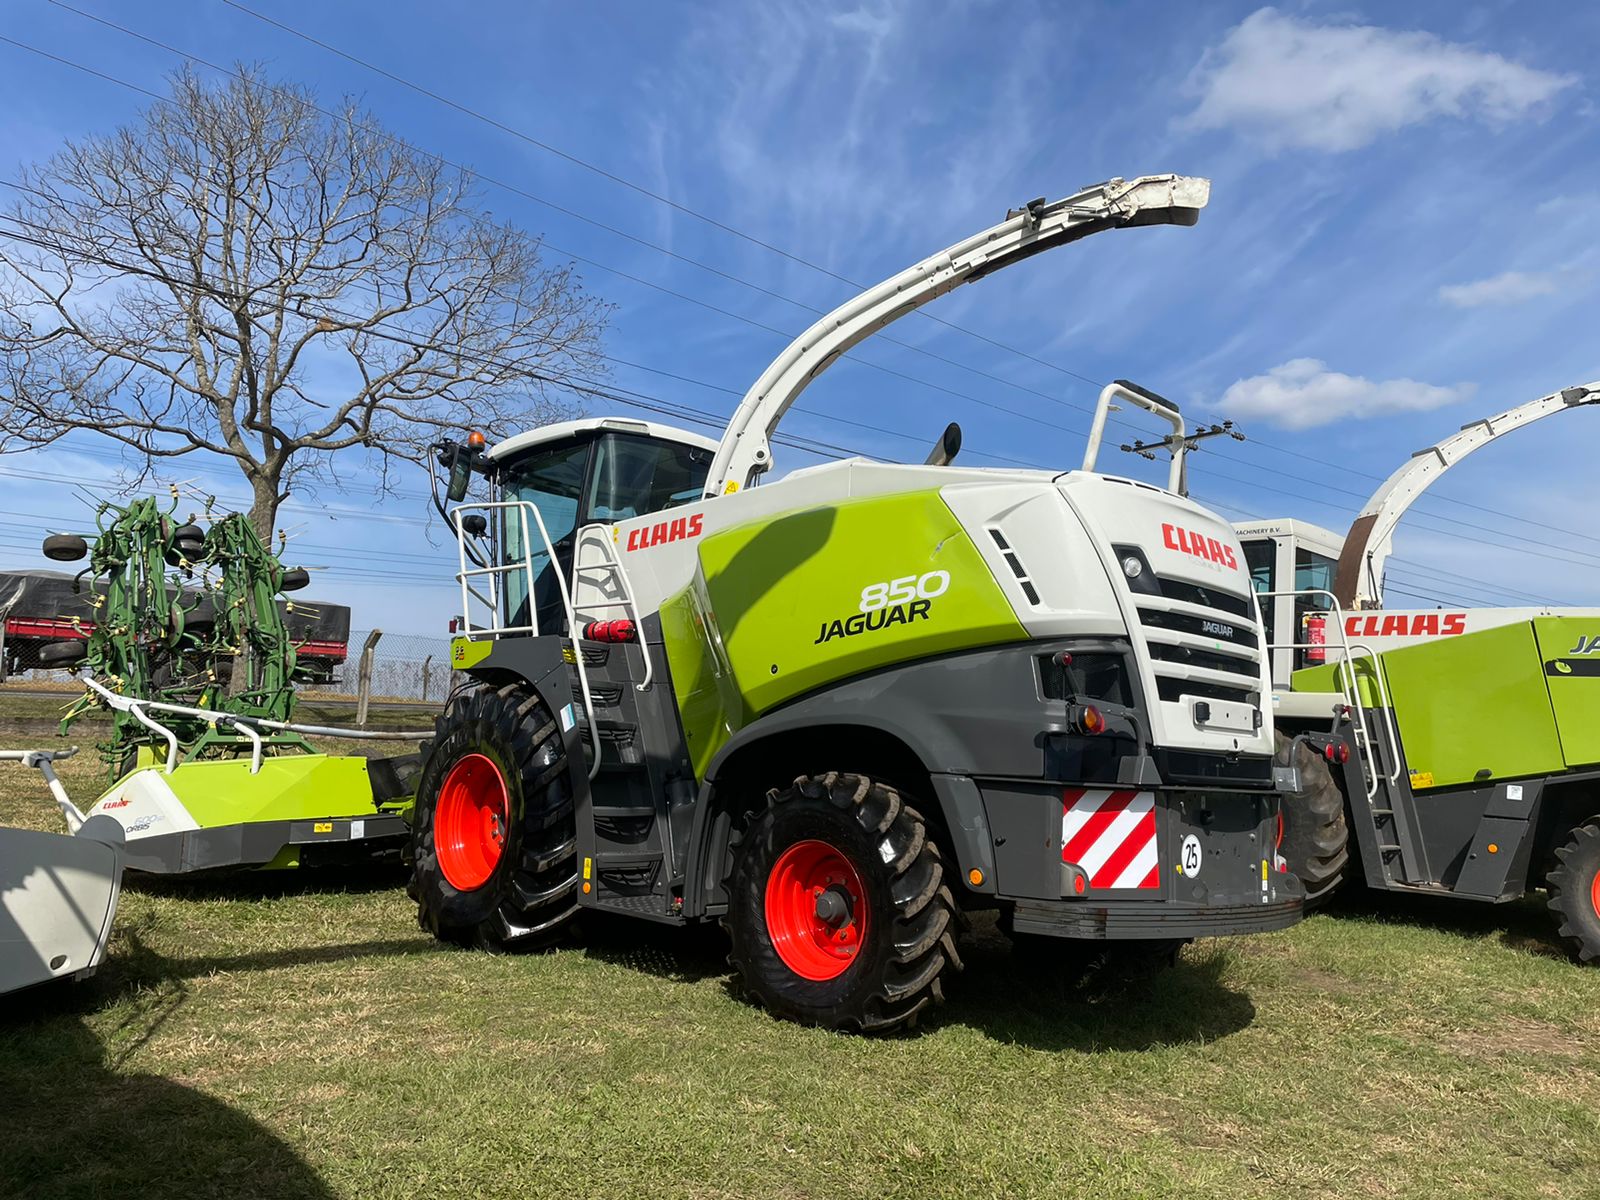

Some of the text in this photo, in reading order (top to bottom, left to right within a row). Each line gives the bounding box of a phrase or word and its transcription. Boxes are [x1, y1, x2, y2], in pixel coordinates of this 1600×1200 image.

[626, 513, 704, 552] CLAAS
[1161, 522, 1238, 571] CLAAS
[859, 569, 951, 613] 850
[814, 599, 931, 645] JAGUAR
[1202, 620, 1234, 638] JAGUAR
[1345, 613, 1466, 637] CLAAS
[1185, 843, 1198, 869] 25
